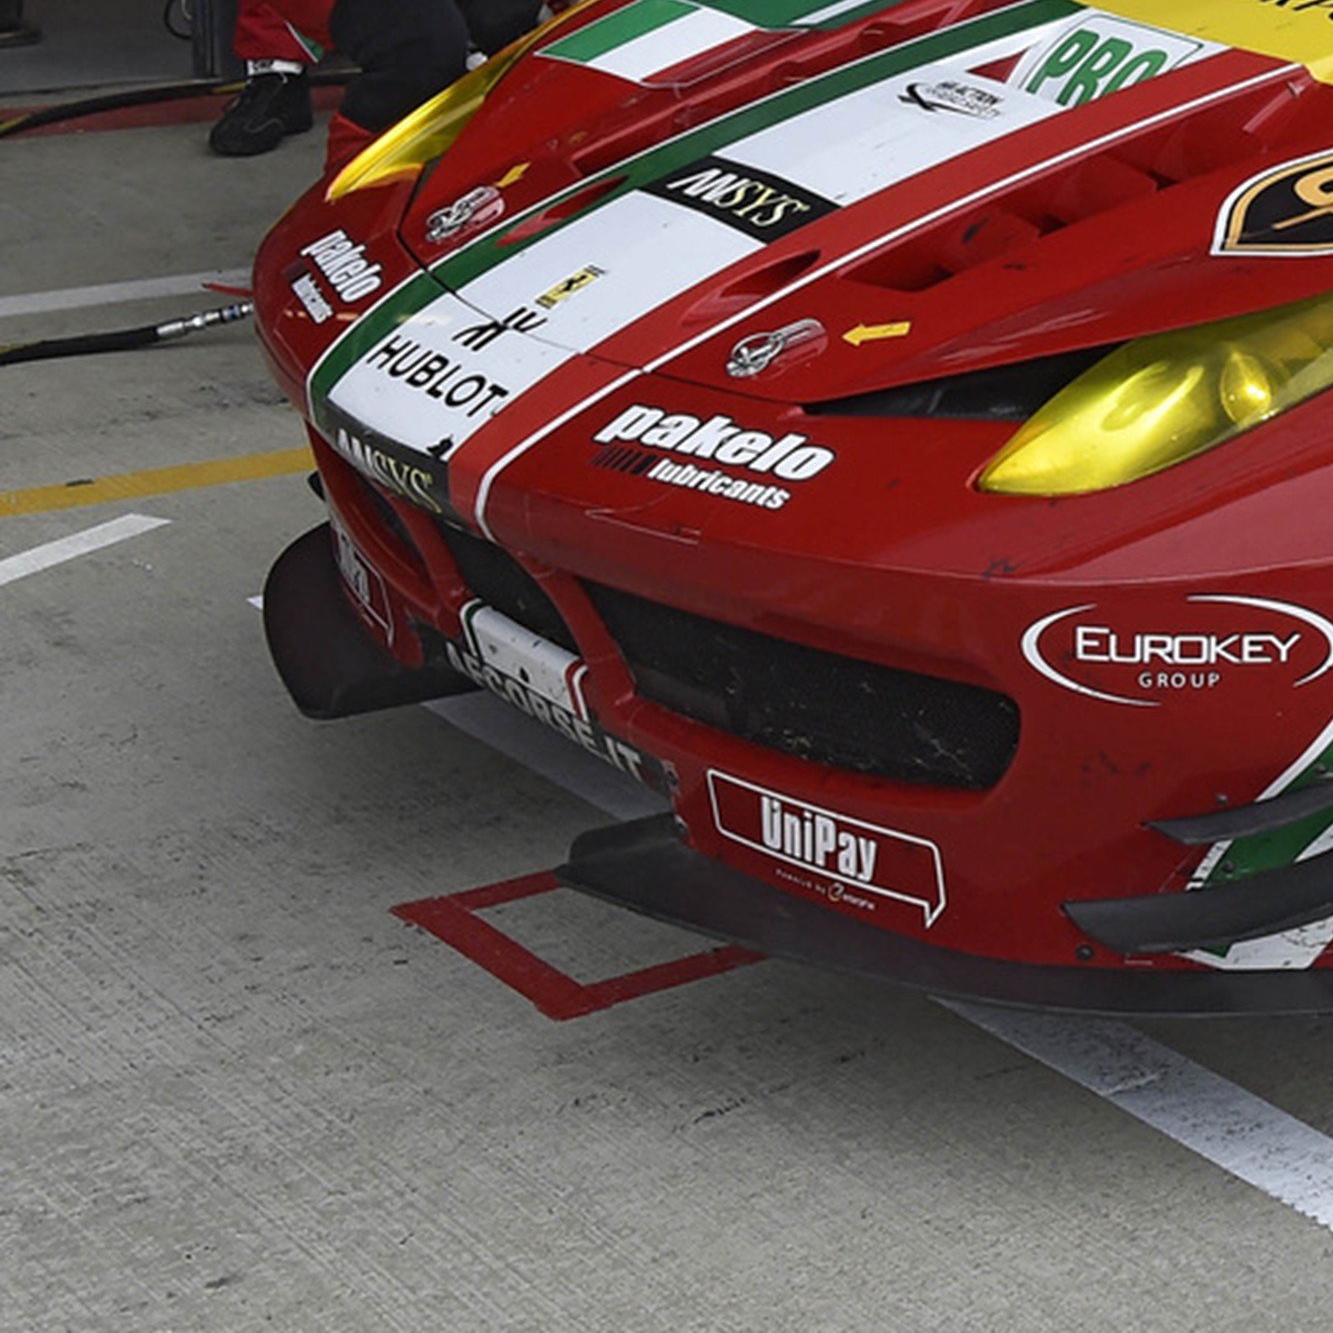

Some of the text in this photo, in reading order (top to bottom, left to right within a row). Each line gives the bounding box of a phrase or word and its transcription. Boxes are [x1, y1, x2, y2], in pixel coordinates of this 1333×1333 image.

[1025, 29, 1168, 107] PRO
[668, 168, 802, 228] ANSYS
[301, 229, 382, 303] pakelo
[367, 335, 509, 417] HUBLOT
[594, 405, 835, 481] pakelo
[648, 458, 791, 509] lubricants
[1076, 625, 1301, 665] EUROKEY
[1139, 670, 1221, 688] GROUP
[762, 795, 877, 883] UniPay
